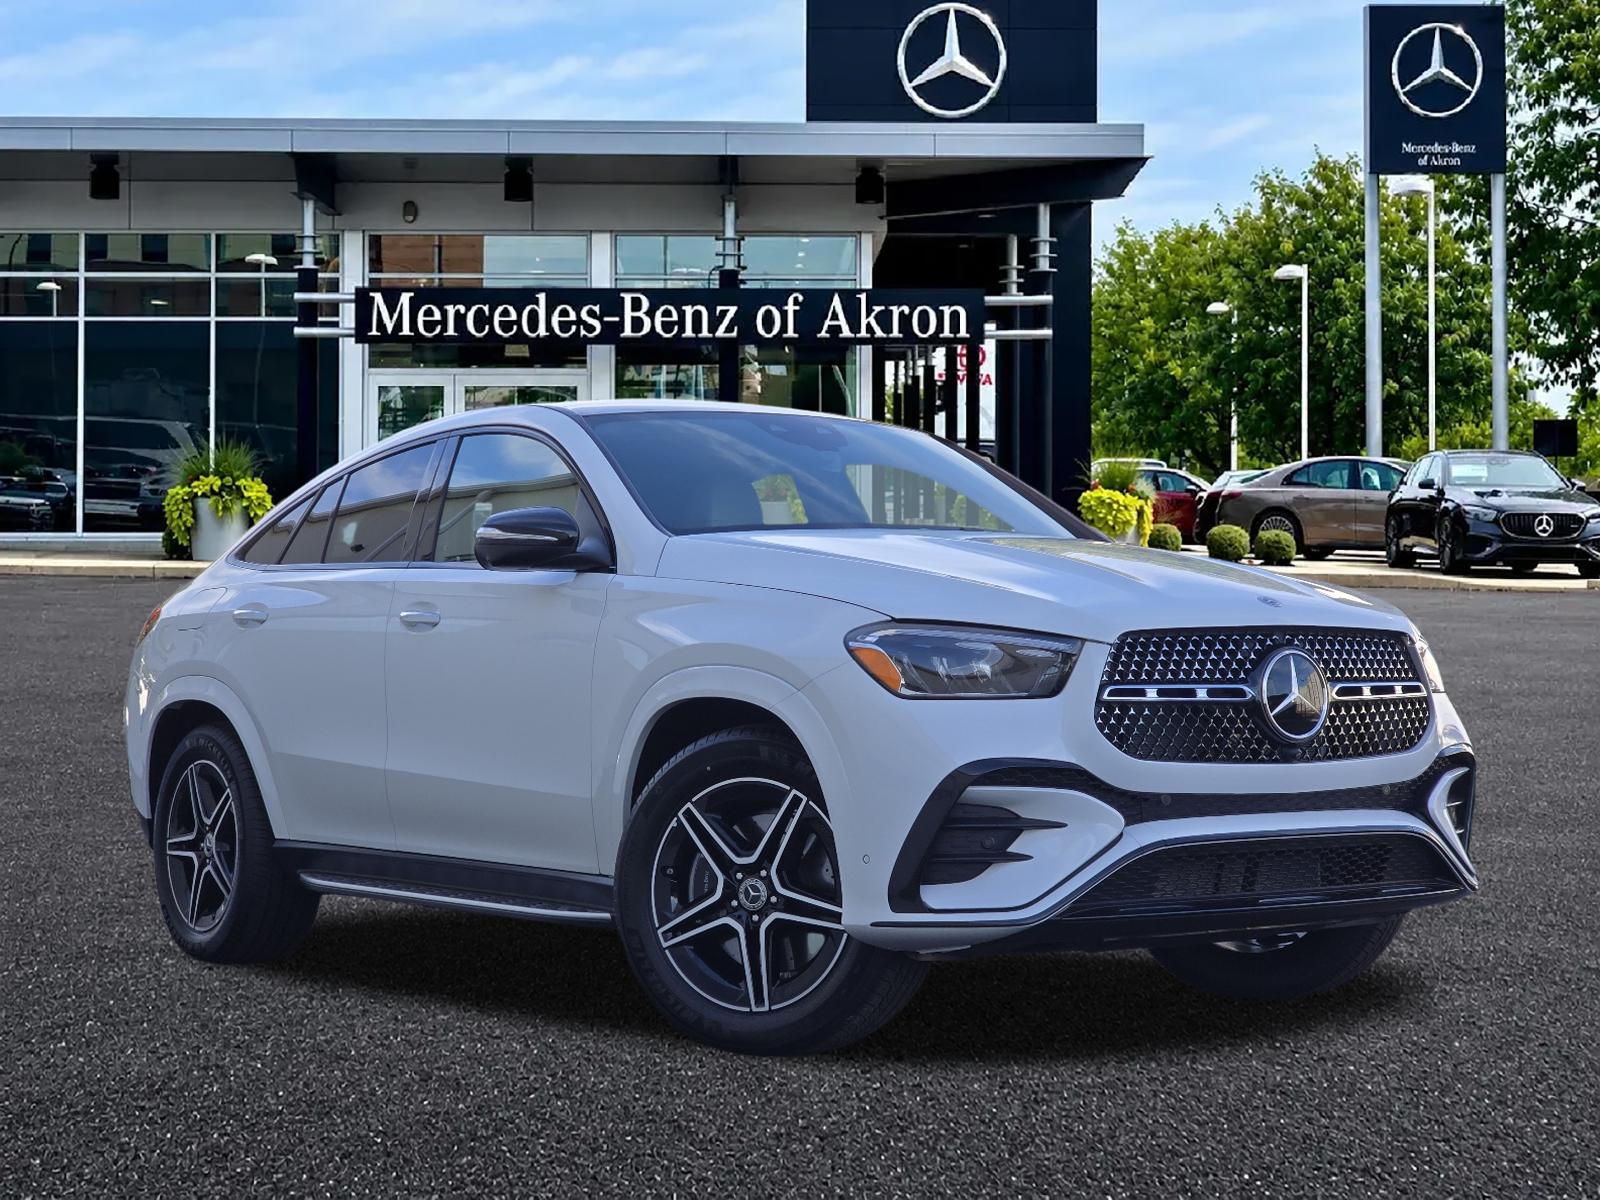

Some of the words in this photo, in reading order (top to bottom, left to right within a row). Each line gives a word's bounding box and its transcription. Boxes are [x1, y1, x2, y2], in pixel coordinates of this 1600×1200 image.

[1401, 142, 1476, 154] Mercedes-Benz
[1417, 155, 1429, 166] of
[1430, 155, 1461, 166] Akron
[367, 291, 738, 338] Mercedes-Benz
[755, 292, 804, 338] of
[816, 291, 971, 338] Akron
